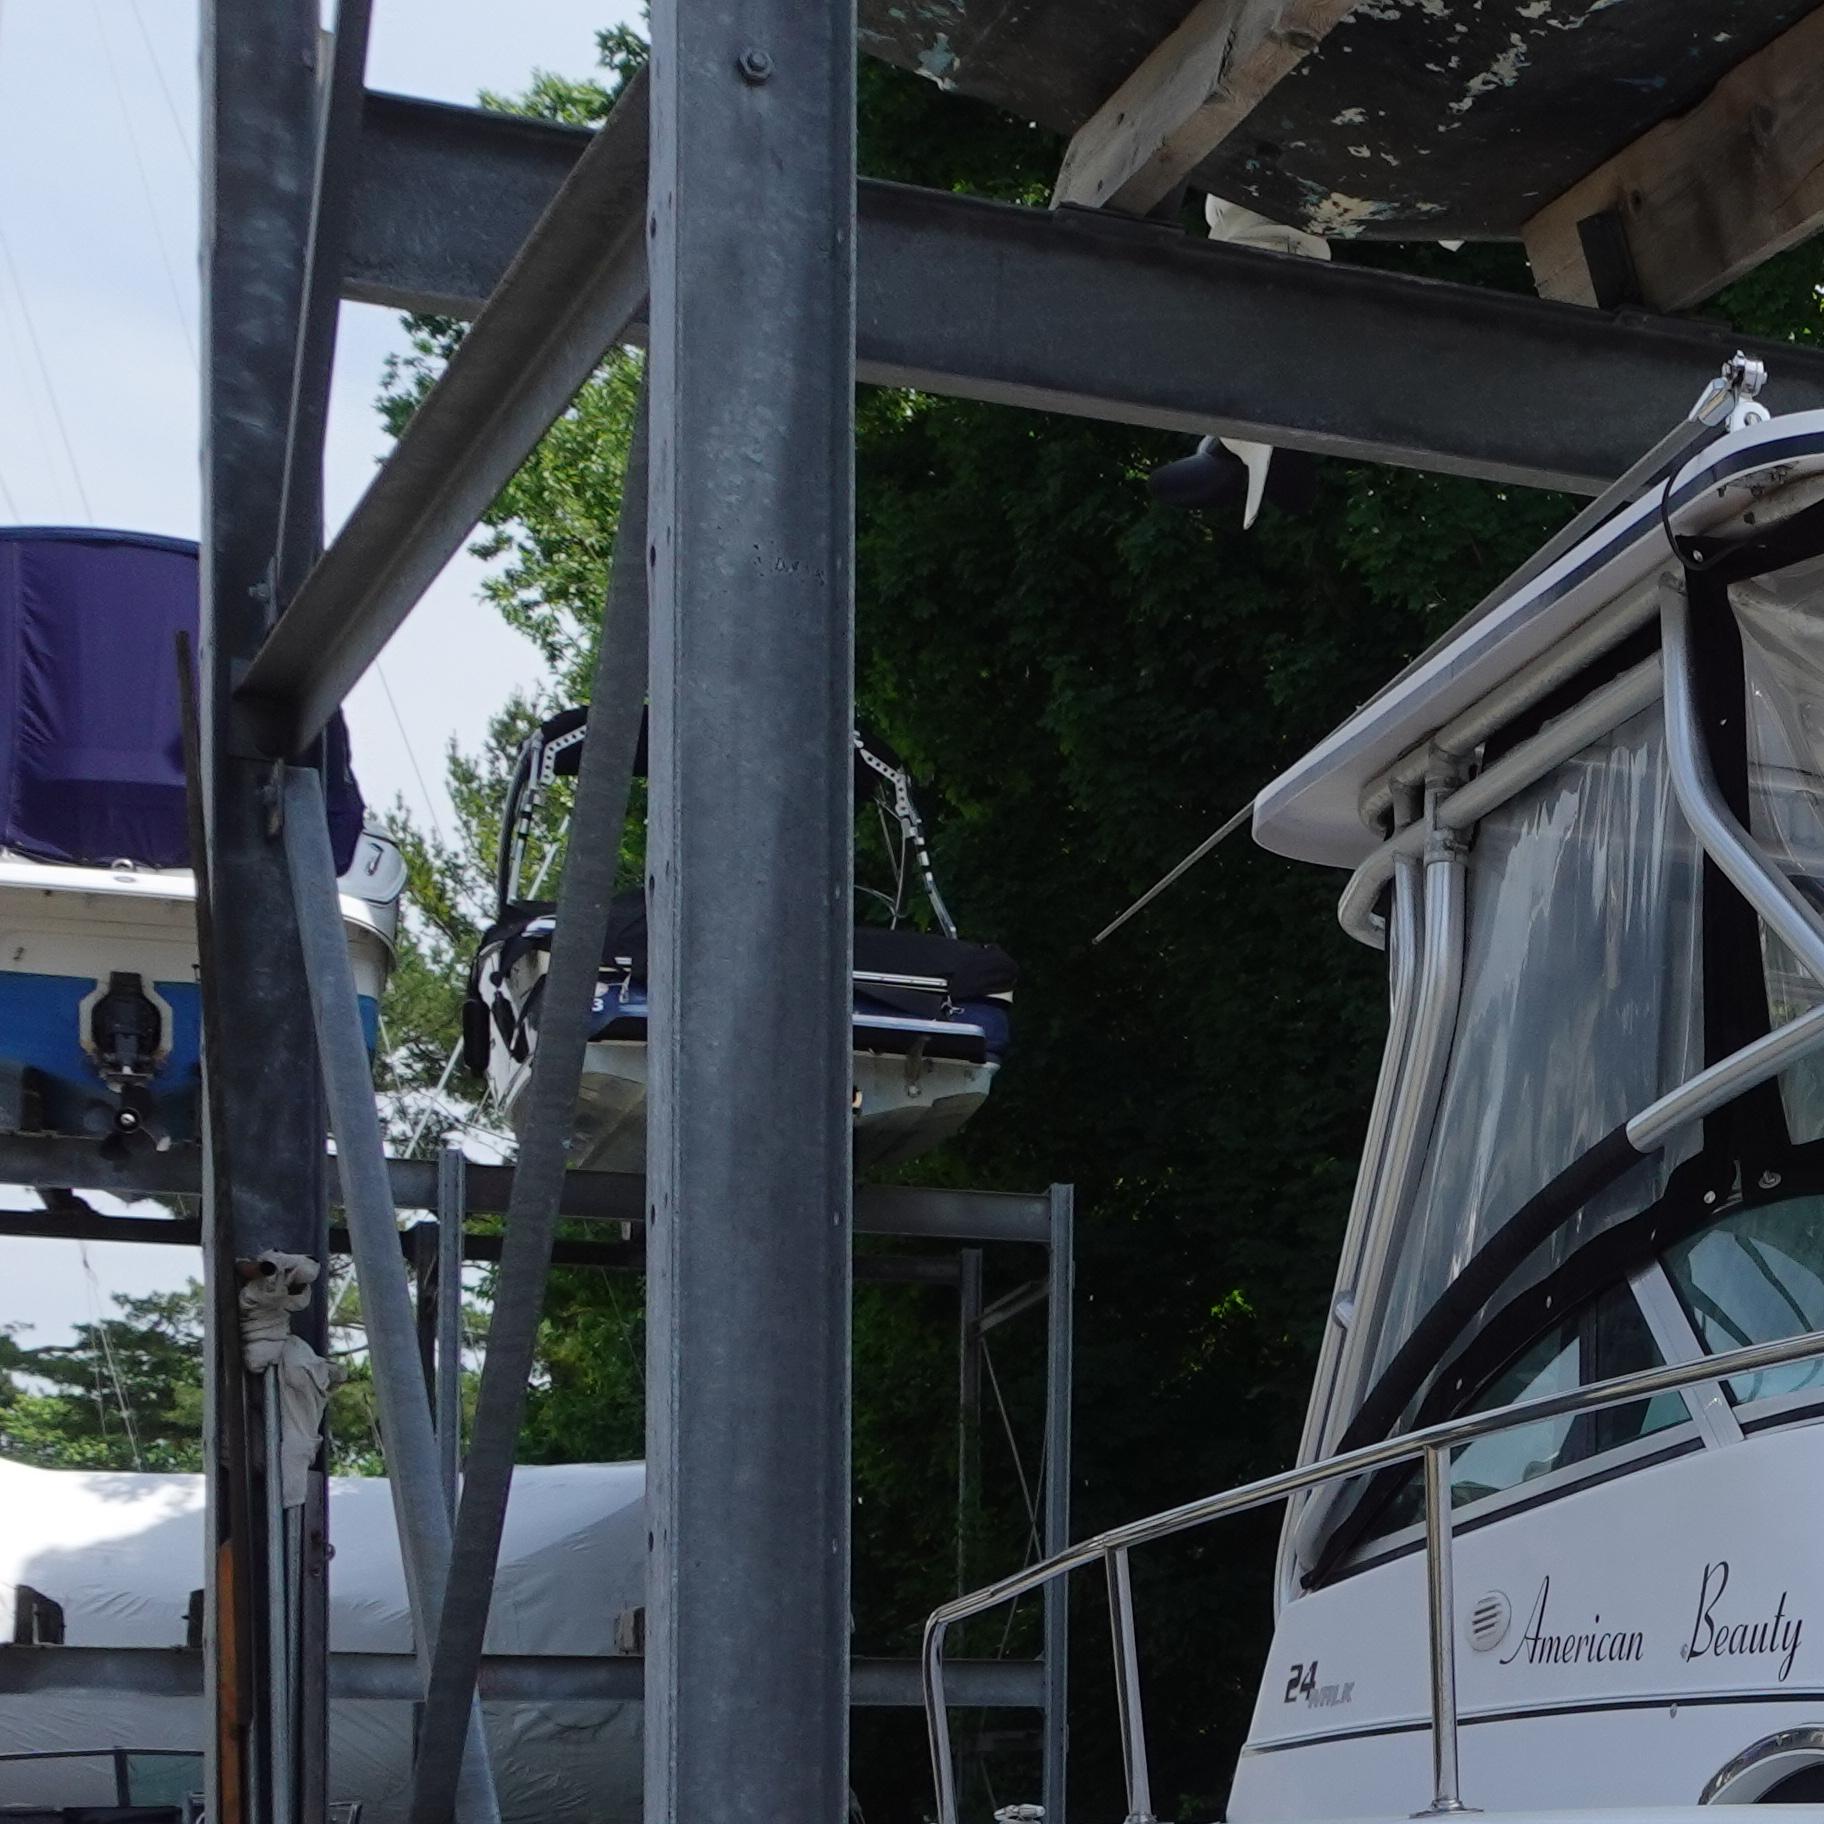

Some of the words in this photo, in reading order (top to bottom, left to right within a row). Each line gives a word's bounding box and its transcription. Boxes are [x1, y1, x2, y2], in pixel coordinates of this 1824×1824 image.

[1499, 1575, 1643, 1665] American
[1687, 1560, 1802, 1682] Beauty
[1284, 1661, 1318, 1703] 24
